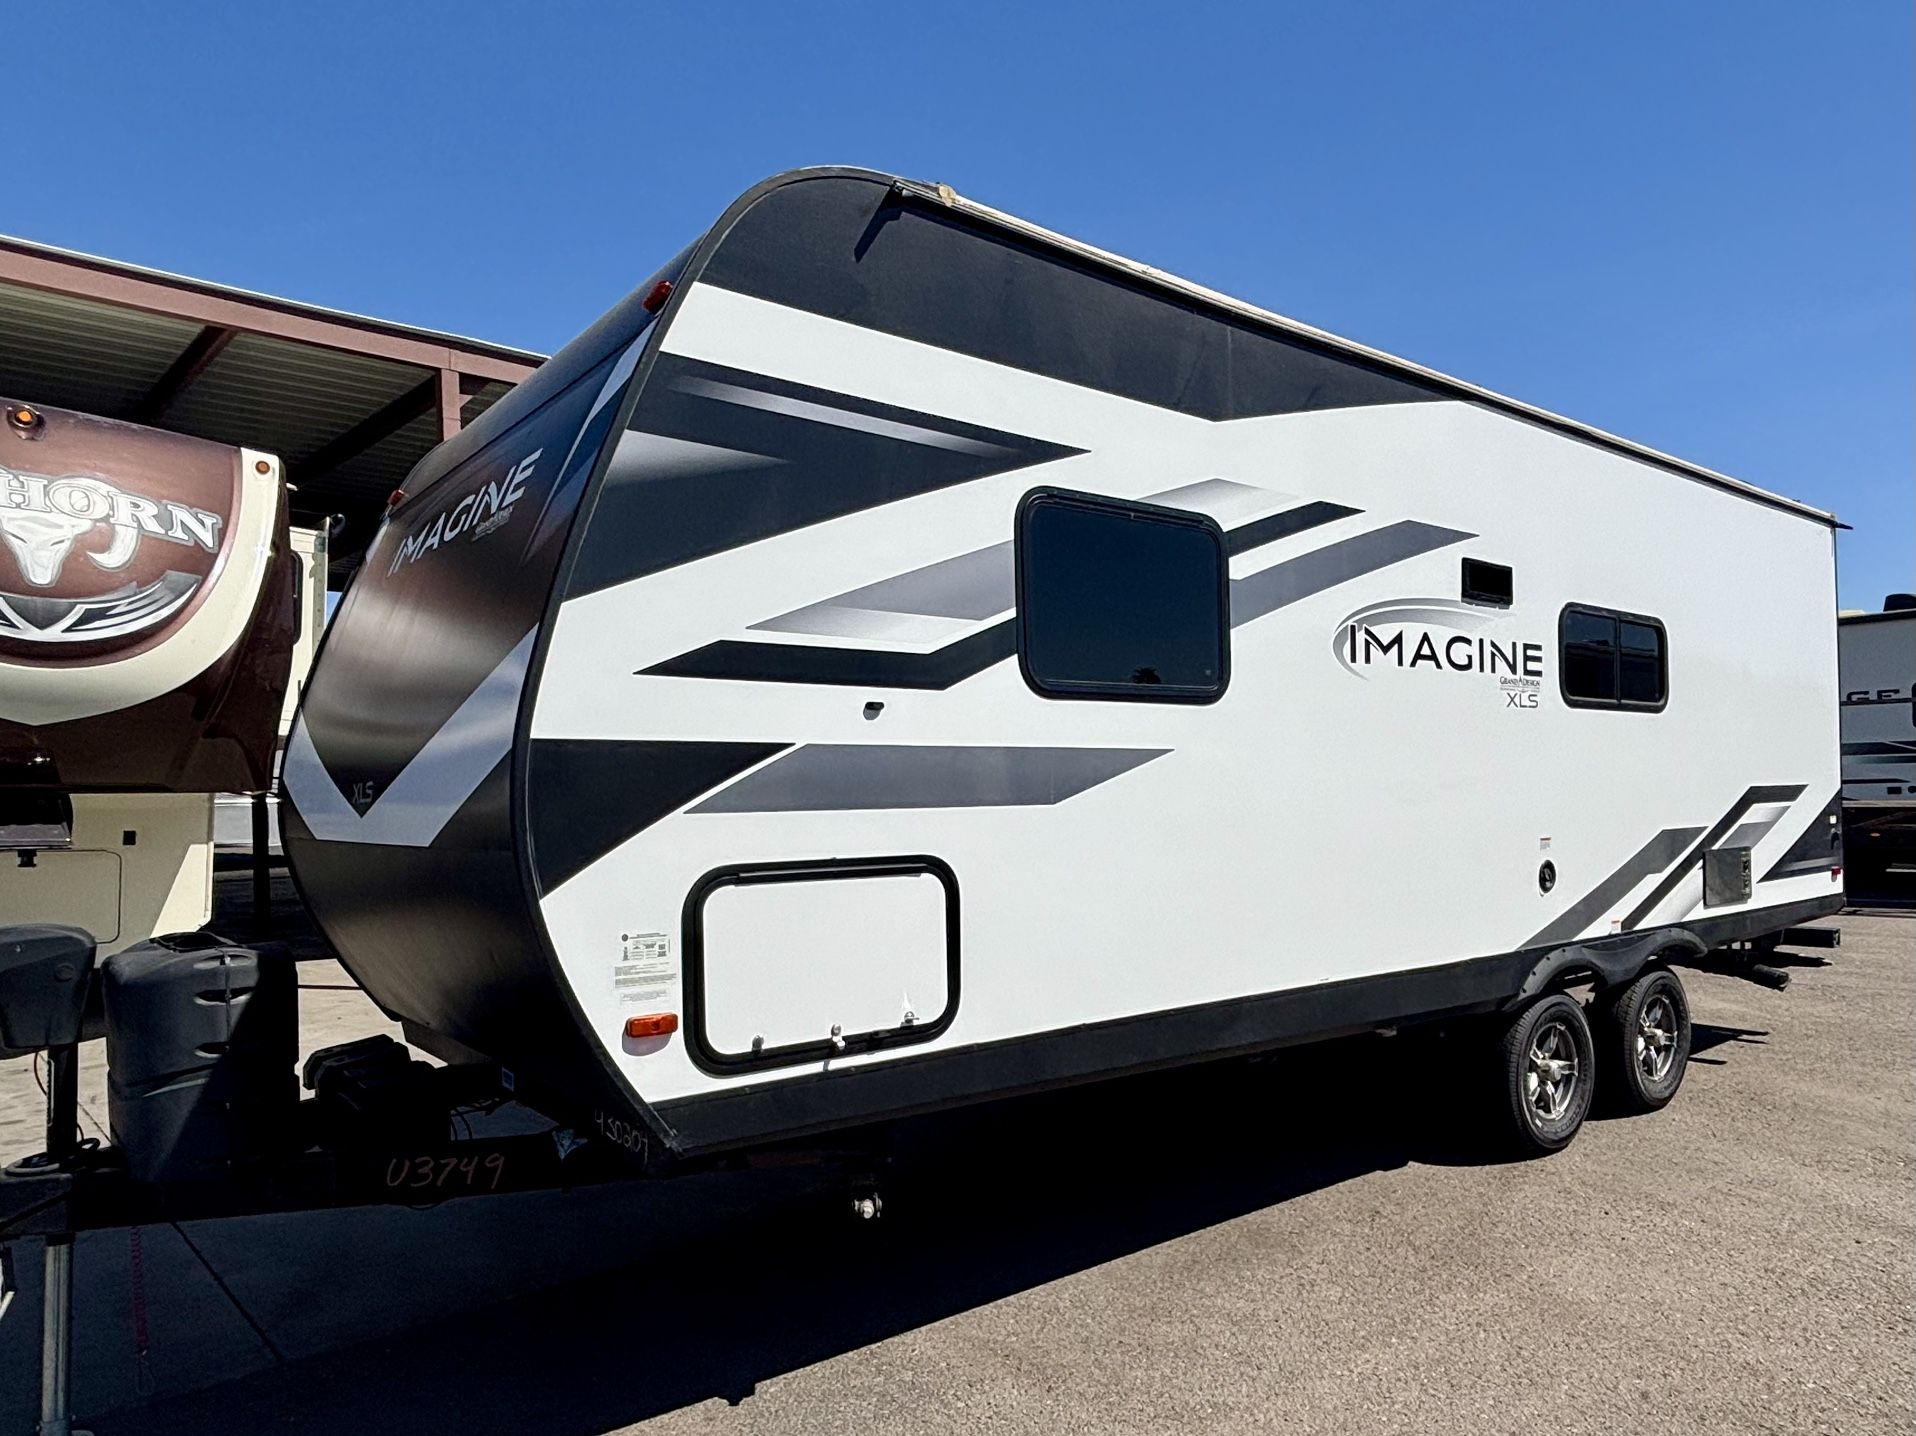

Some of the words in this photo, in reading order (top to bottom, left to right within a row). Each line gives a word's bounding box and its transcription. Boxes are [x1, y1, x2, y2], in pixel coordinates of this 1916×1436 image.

[386, 447, 544, 578] IMAGINE
[1349, 624, 1543, 678] IMAGINE
[1506, 692, 1539, 709] XLS
[352, 781, 375, 804] XLS
[386, 1153, 505, 1190] U3749
